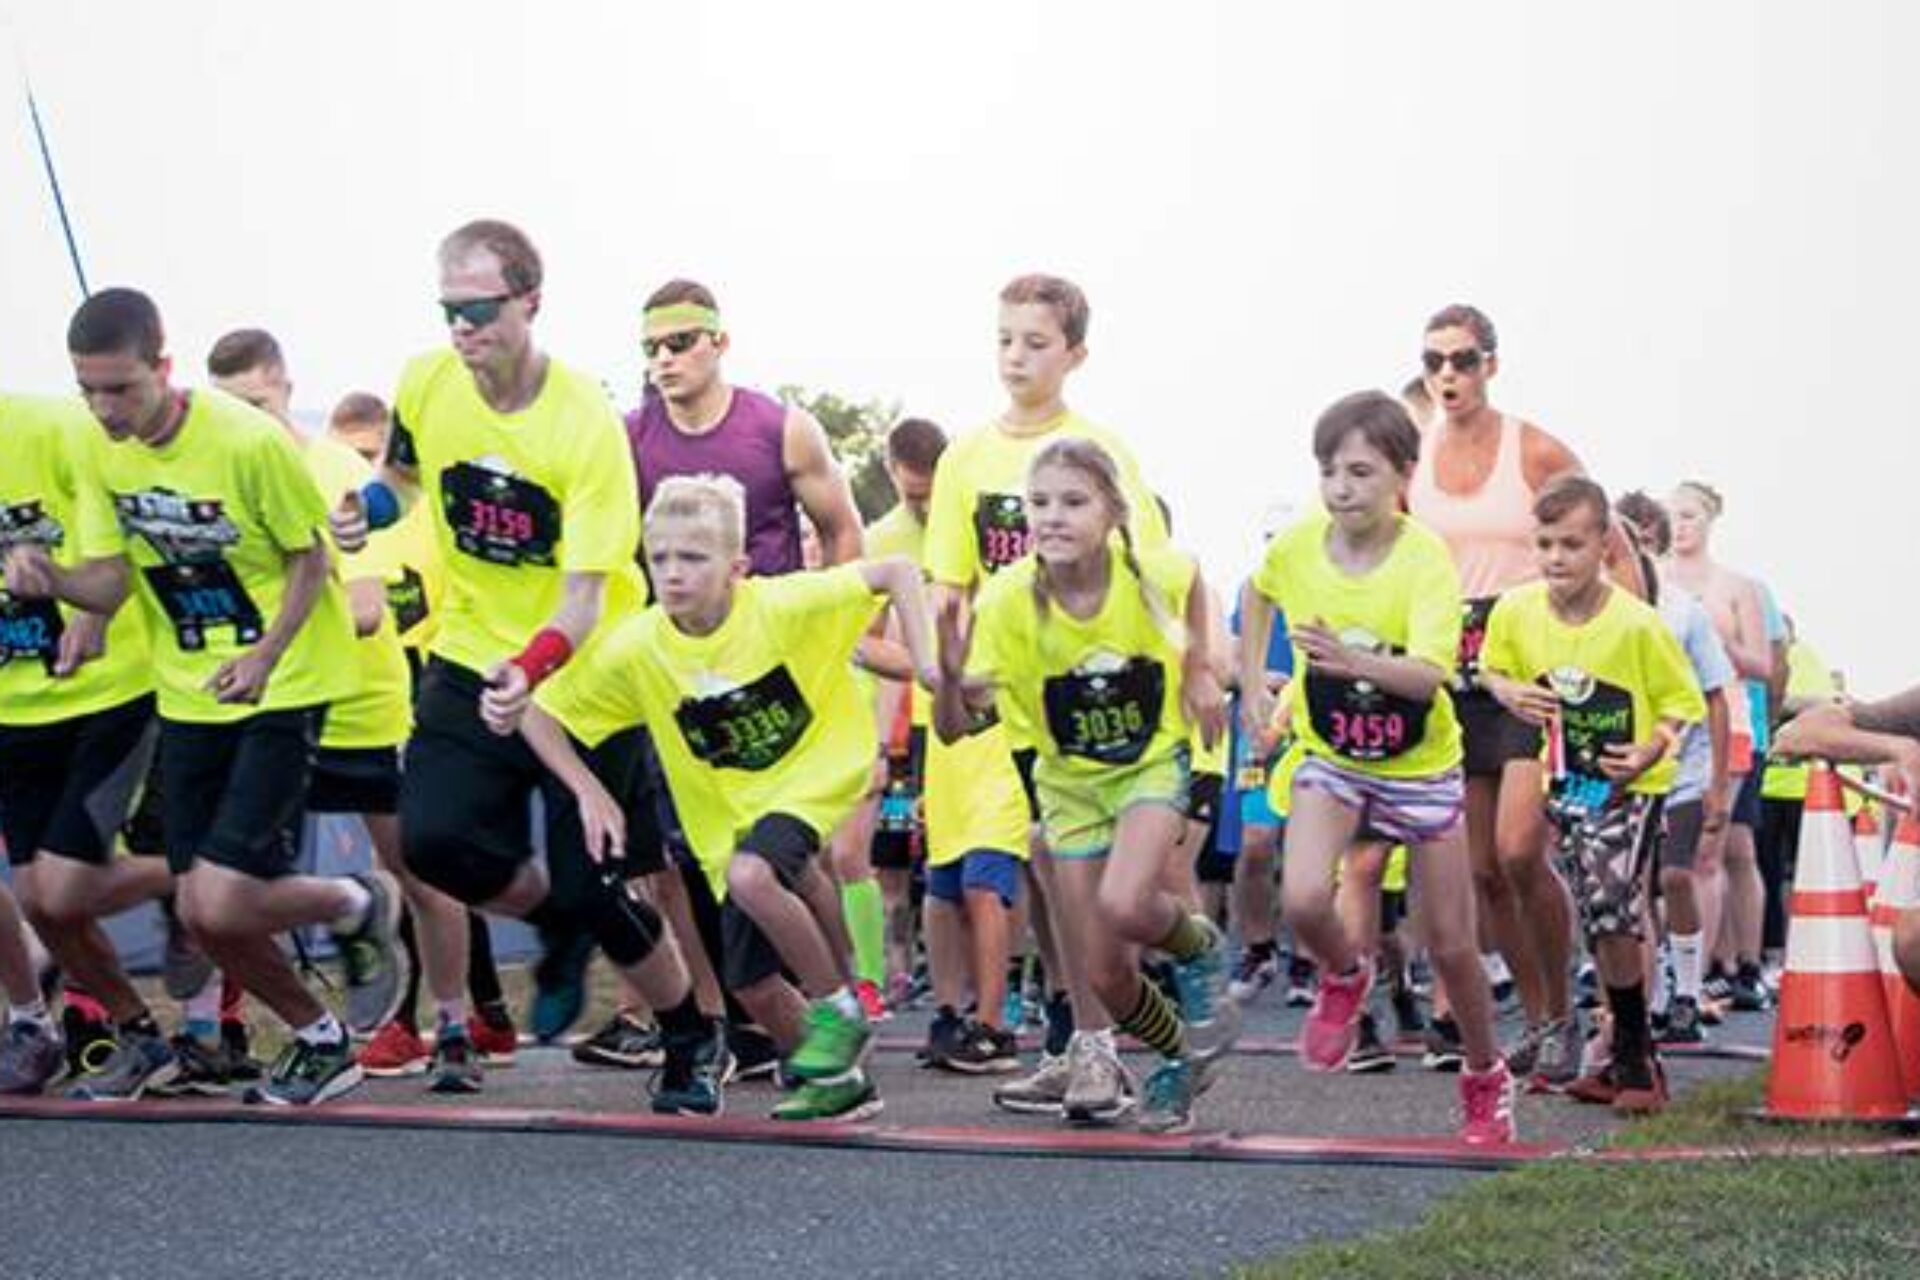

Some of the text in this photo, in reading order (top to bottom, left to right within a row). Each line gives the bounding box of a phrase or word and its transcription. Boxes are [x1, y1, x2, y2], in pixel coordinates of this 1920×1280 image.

[471, 498, 532, 540] 3159
[718, 700, 790, 753] 3336
[1071, 701, 1142, 742] 3036
[1329, 711, 1405, 748] 3459
